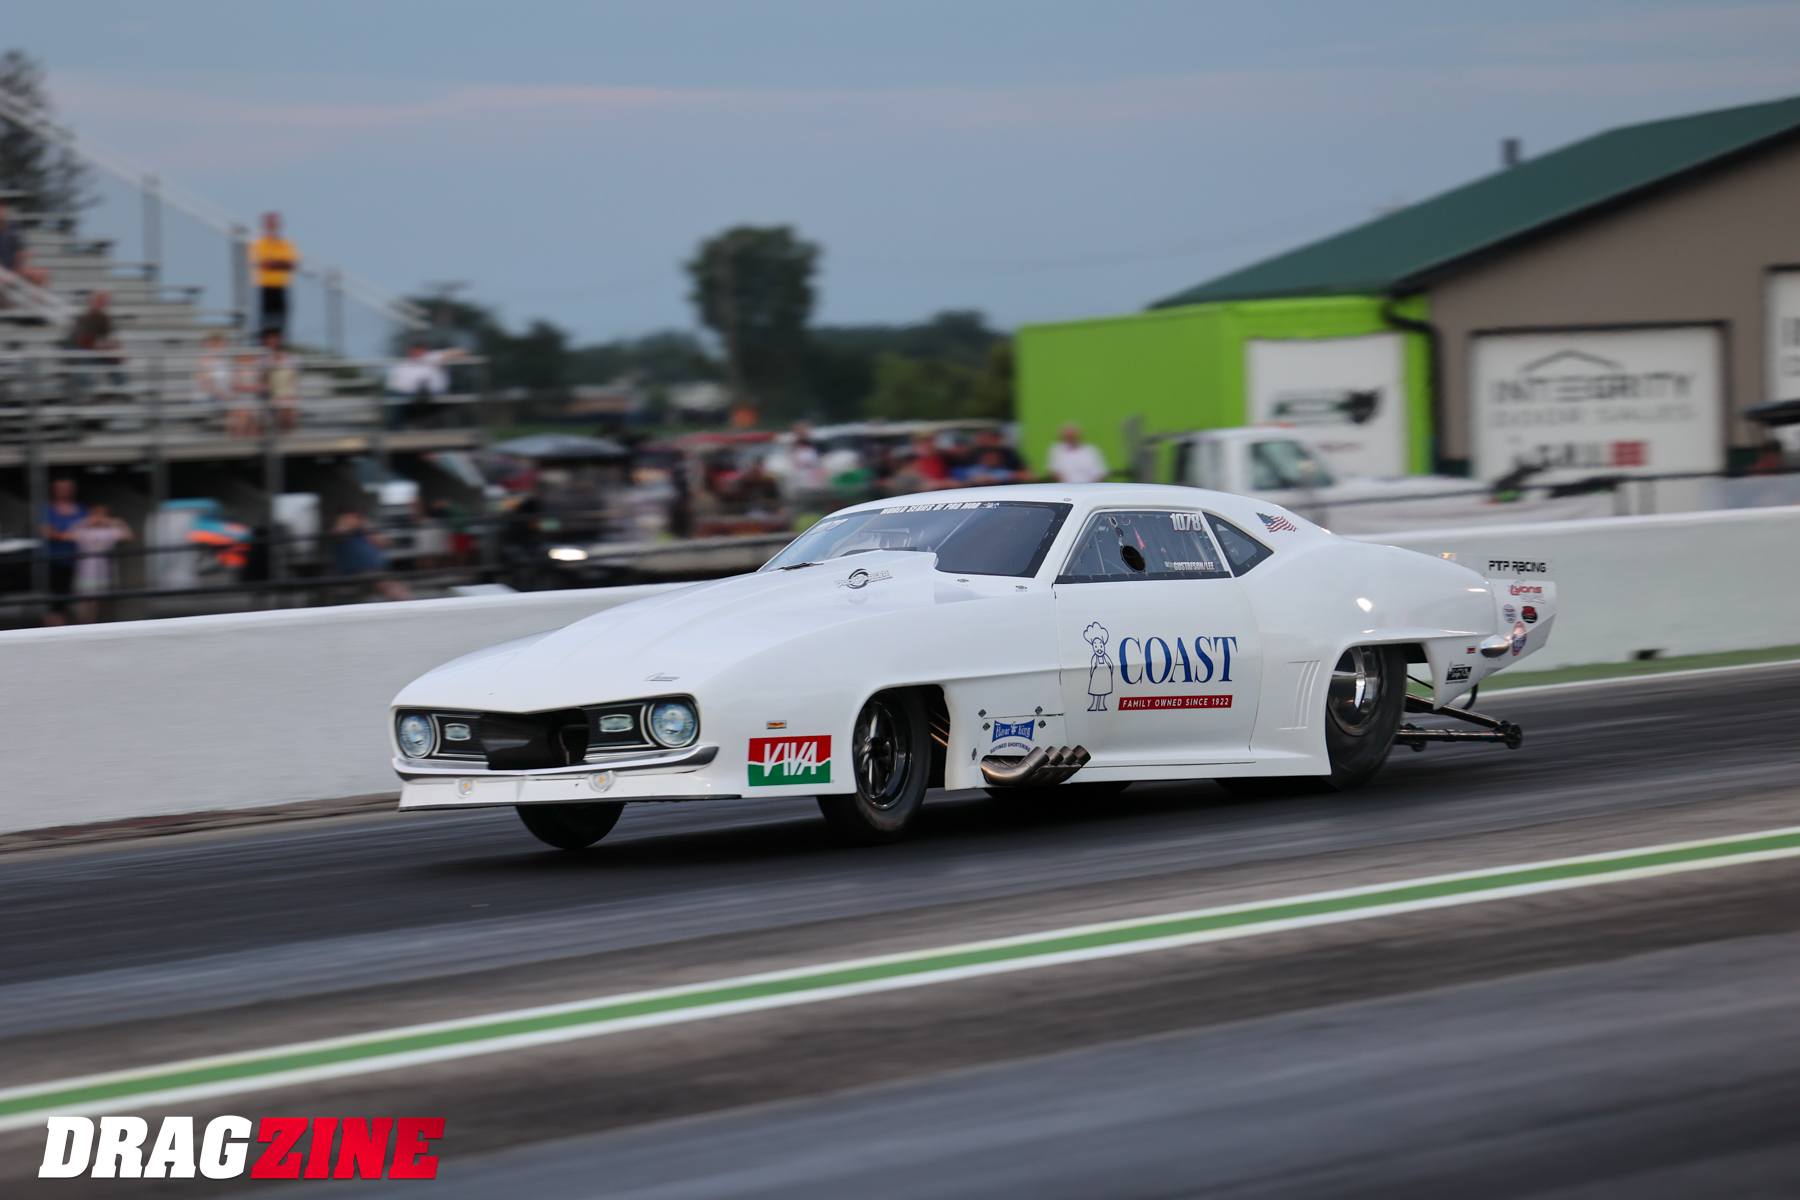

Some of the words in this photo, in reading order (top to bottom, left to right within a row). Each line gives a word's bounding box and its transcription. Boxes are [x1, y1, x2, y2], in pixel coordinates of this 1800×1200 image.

[906, 503, 936, 513] SERIES
[1488, 560, 1510, 571] PTP
[1512, 561, 1546, 575] RACING
[1119, 636, 1238, 684] COAST
[1122, 699, 1152, 708] FAMILY
[1154, 698, 1182, 707] OWNED
[1185, 698, 1208, 706] SINCE
[1211, 697, 1229, 706] 1922
[763, 741, 818, 777] VIVA
